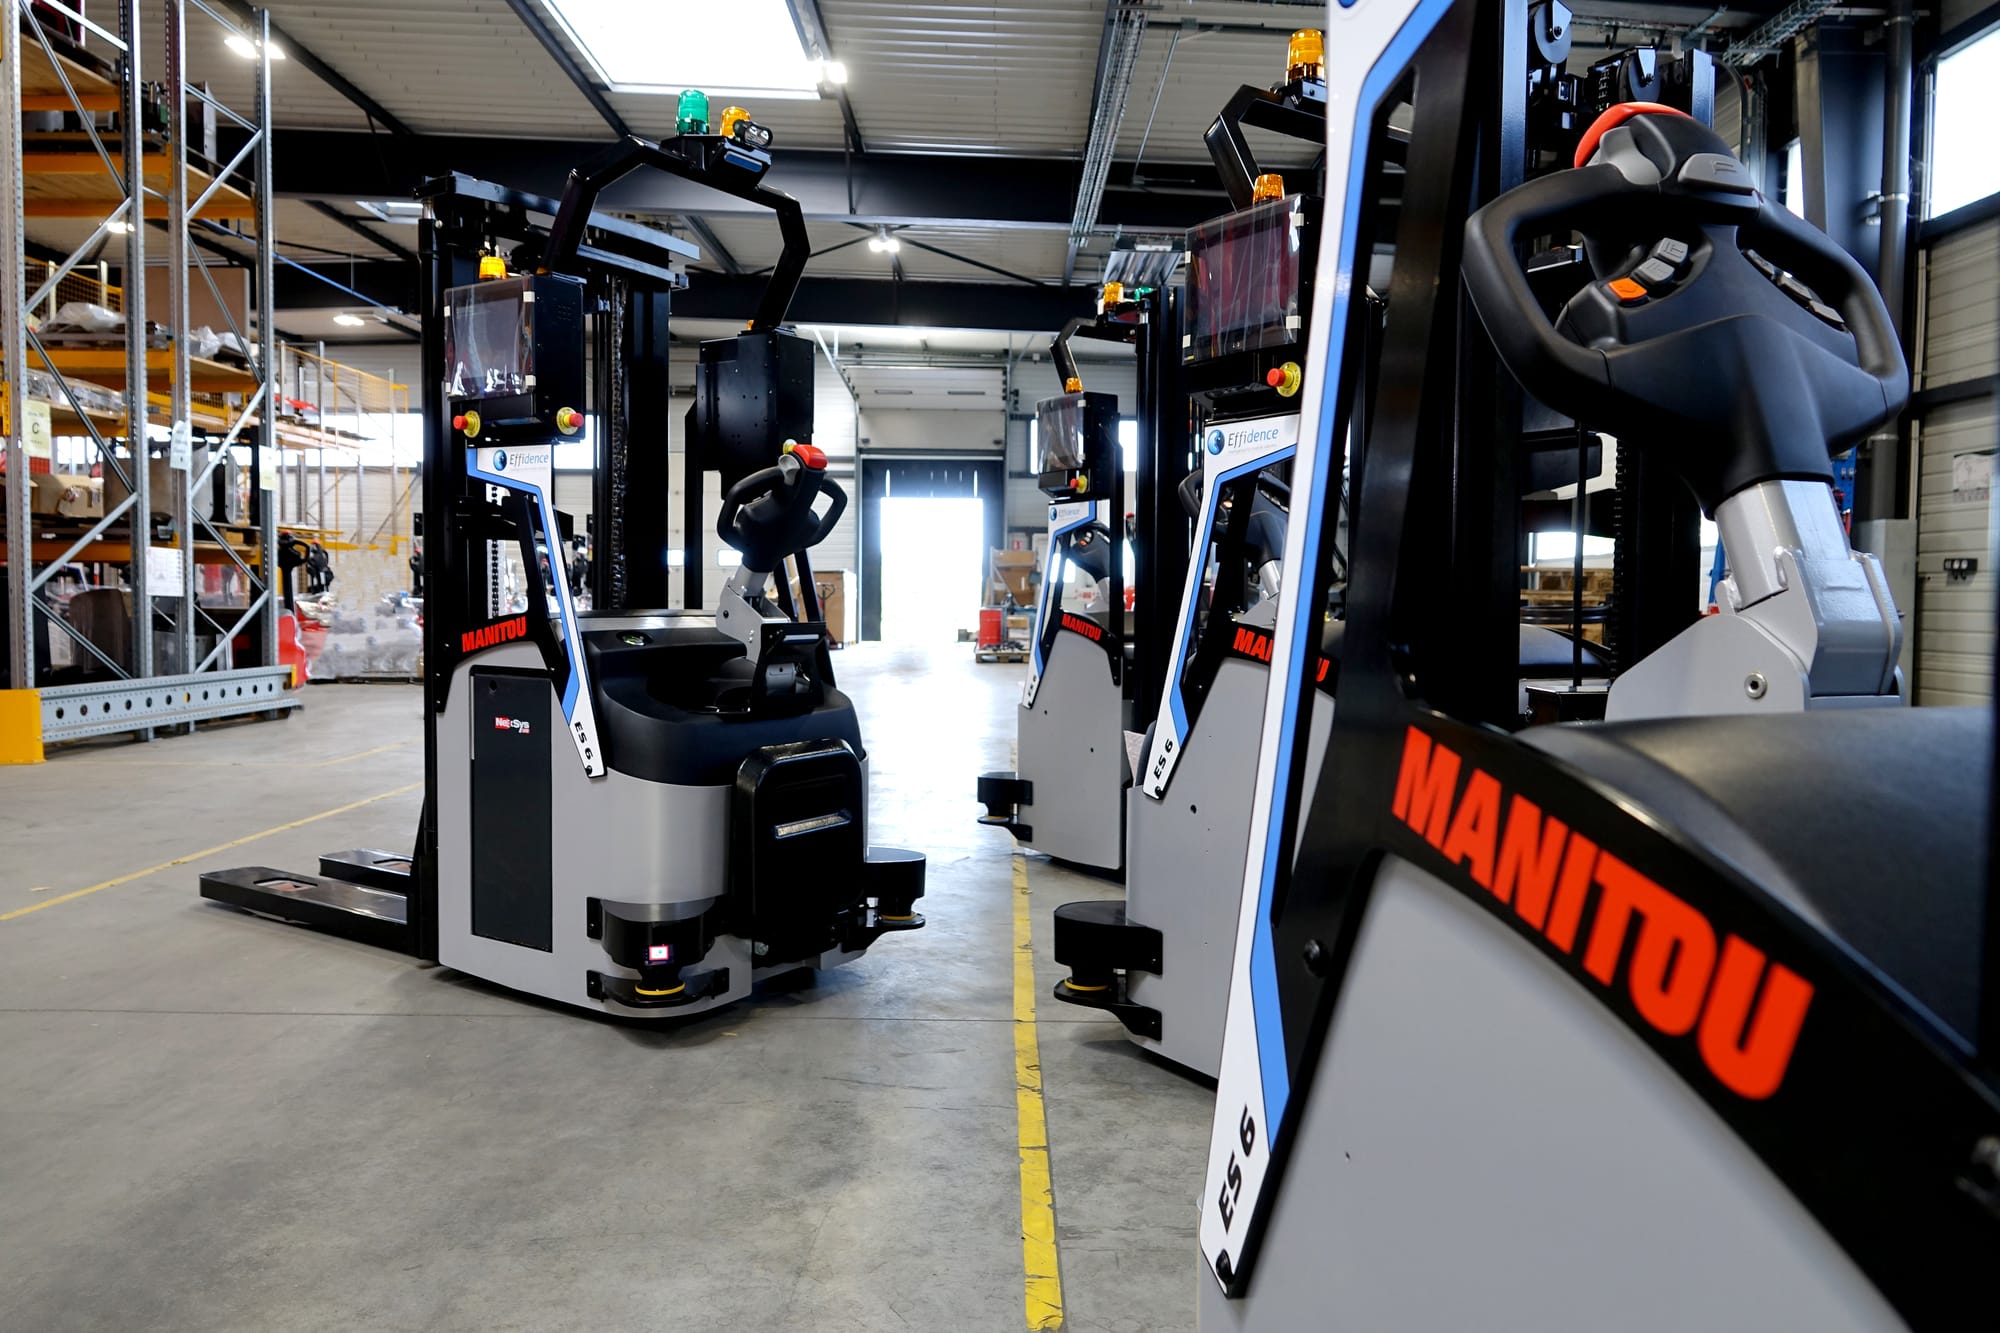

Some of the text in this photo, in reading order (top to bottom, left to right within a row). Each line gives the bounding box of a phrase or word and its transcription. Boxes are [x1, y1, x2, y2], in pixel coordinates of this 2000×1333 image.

[1228, 428, 1279, 448] Effidence
[509, 453, 549, 467] Effidence
[462, 616, 526, 652] MANITOU
[1061, 613, 1102, 641] MANITOU
[574, 721, 593, 760] ES 6
[1153, 738, 1173, 780] ES 6
[1392, 724, 1815, 1100] MANITOU
[1218, 1104, 1255, 1235] ES 6
